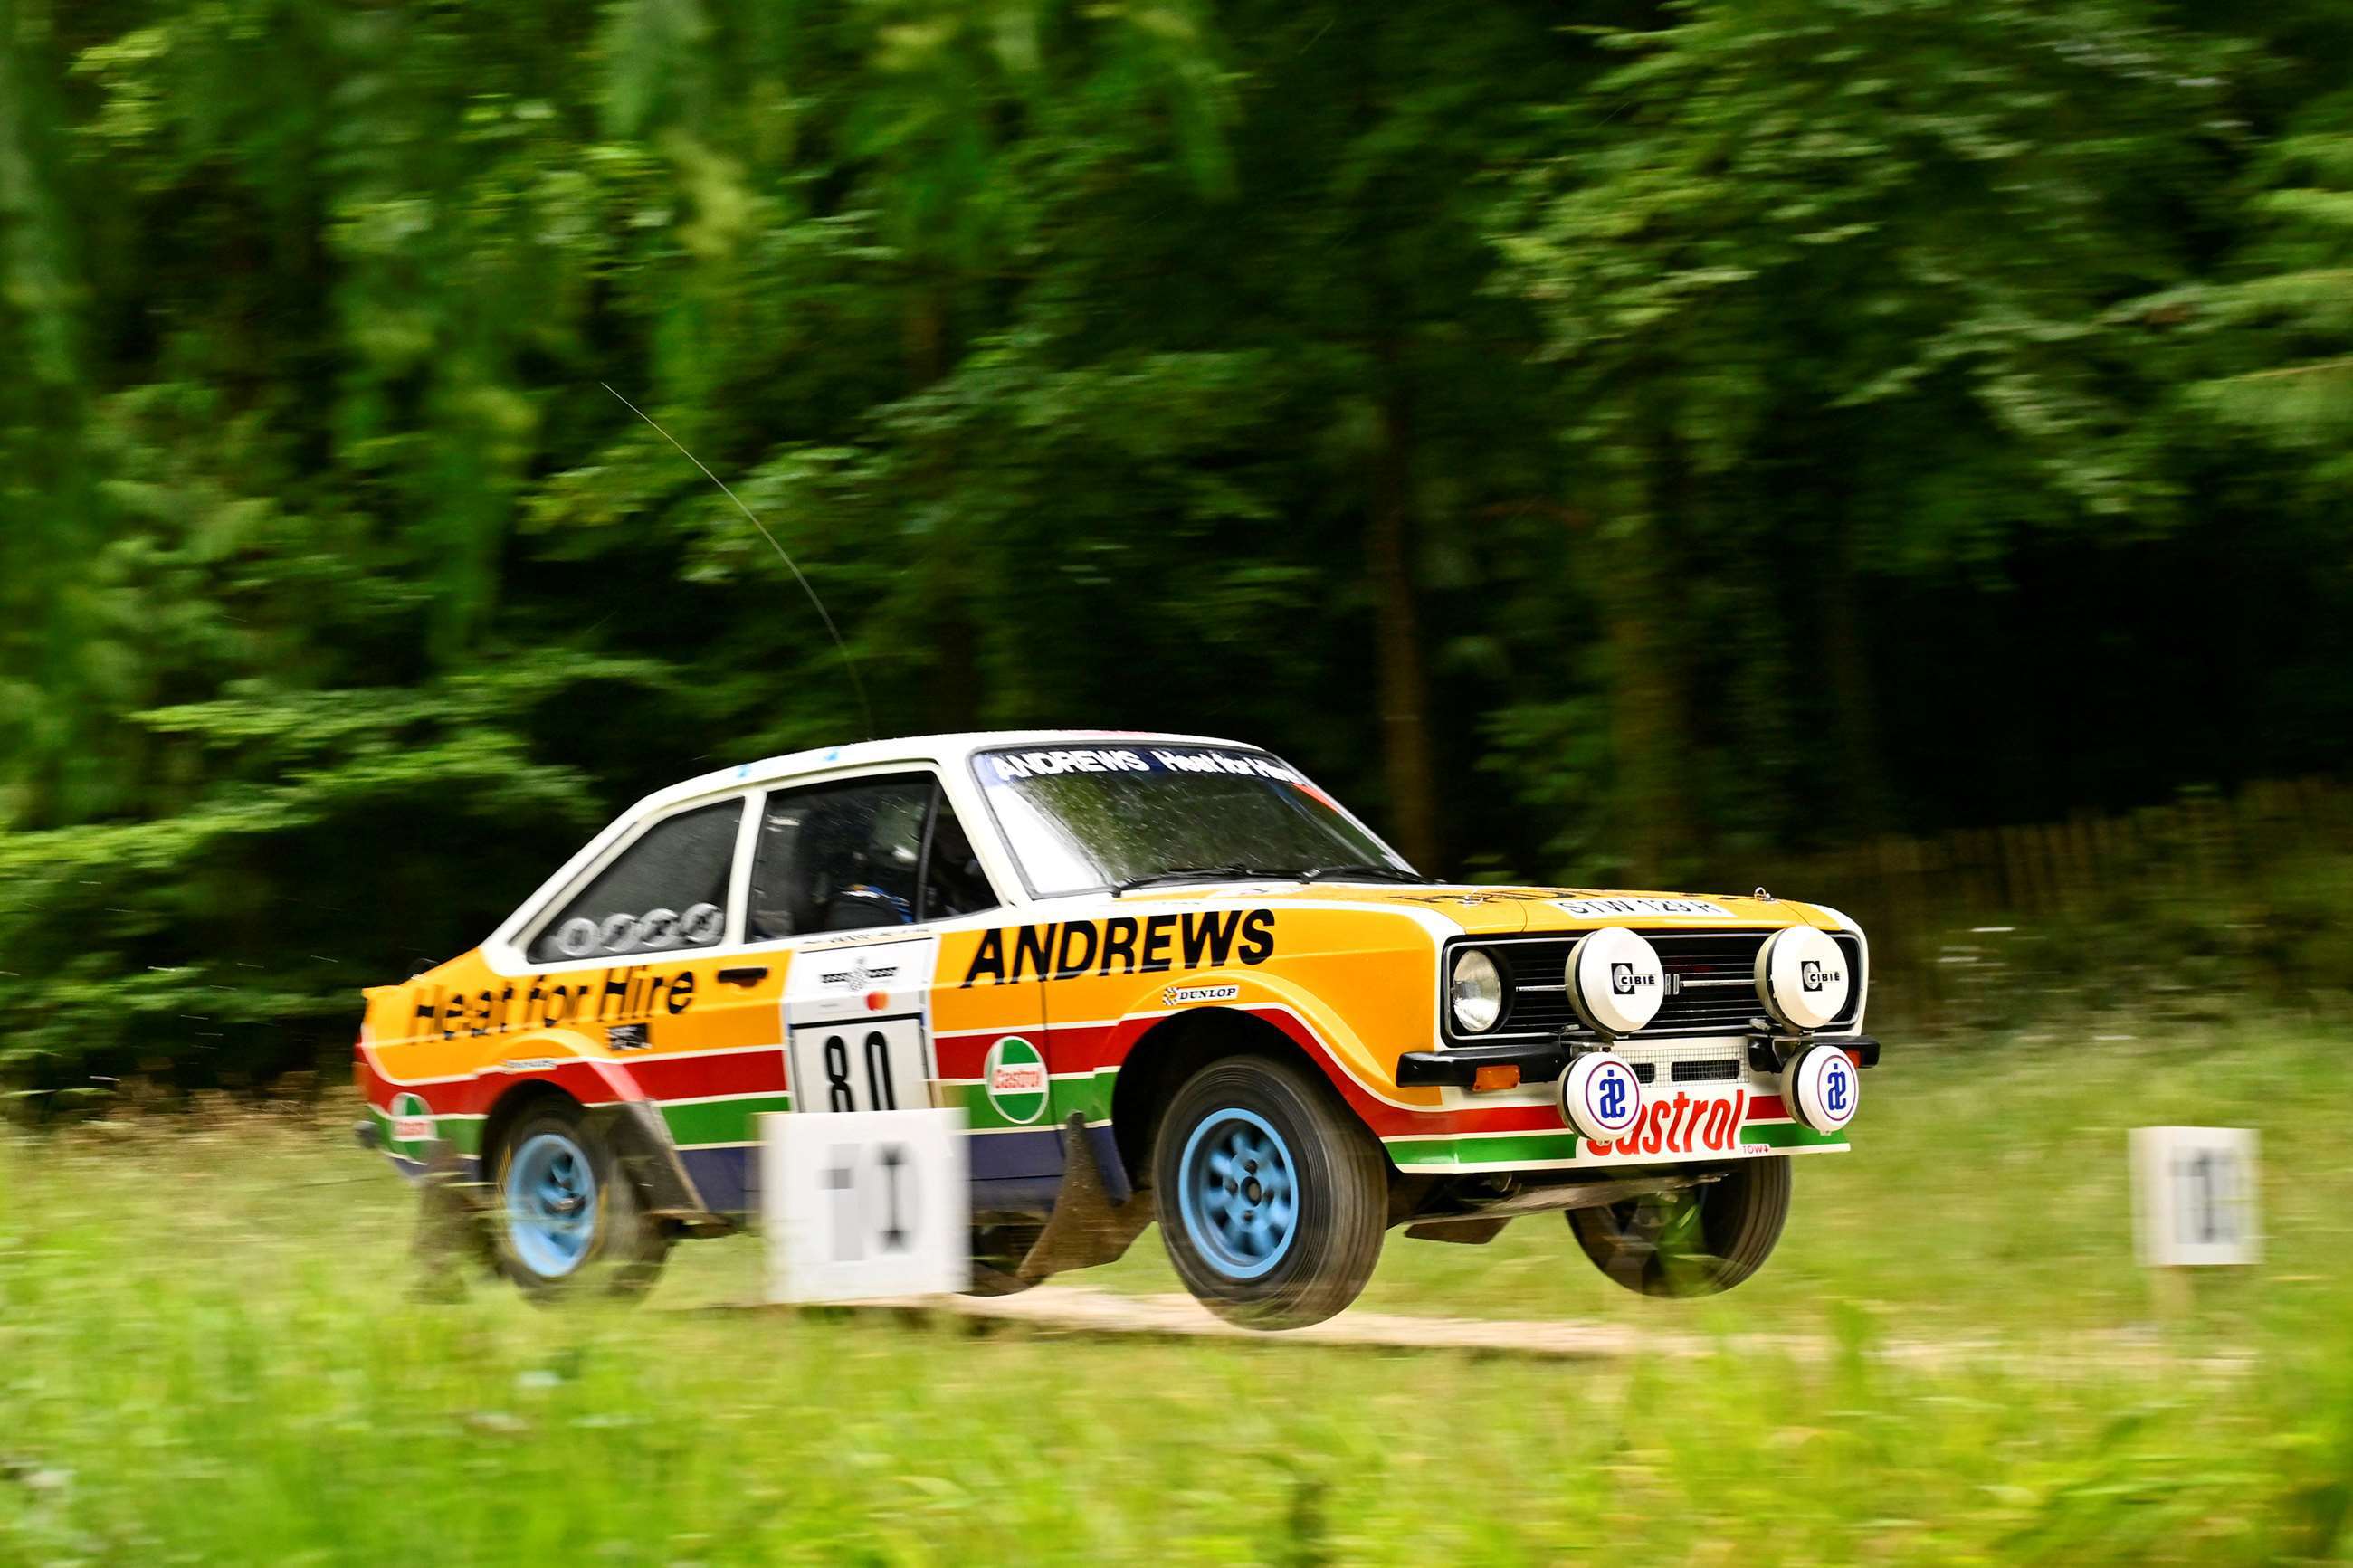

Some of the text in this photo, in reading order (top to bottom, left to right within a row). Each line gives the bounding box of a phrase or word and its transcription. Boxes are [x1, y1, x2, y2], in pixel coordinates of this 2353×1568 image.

[991, 750, 1150, 781] ANDREWS
[1150, 750, 1217, 773] Heat
[1558, 900, 1634, 914] STW
[958, 908, 1275, 988] ANDREWS
[407, 965, 693, 1045] Heat for Hire
[1180, 988, 1236, 1000] DUNLOP
[824, 1031, 896, 1112] 80
[1586, 1089, 1744, 1156] astrol
[1742, 1145, 1762, 1154] TOW
